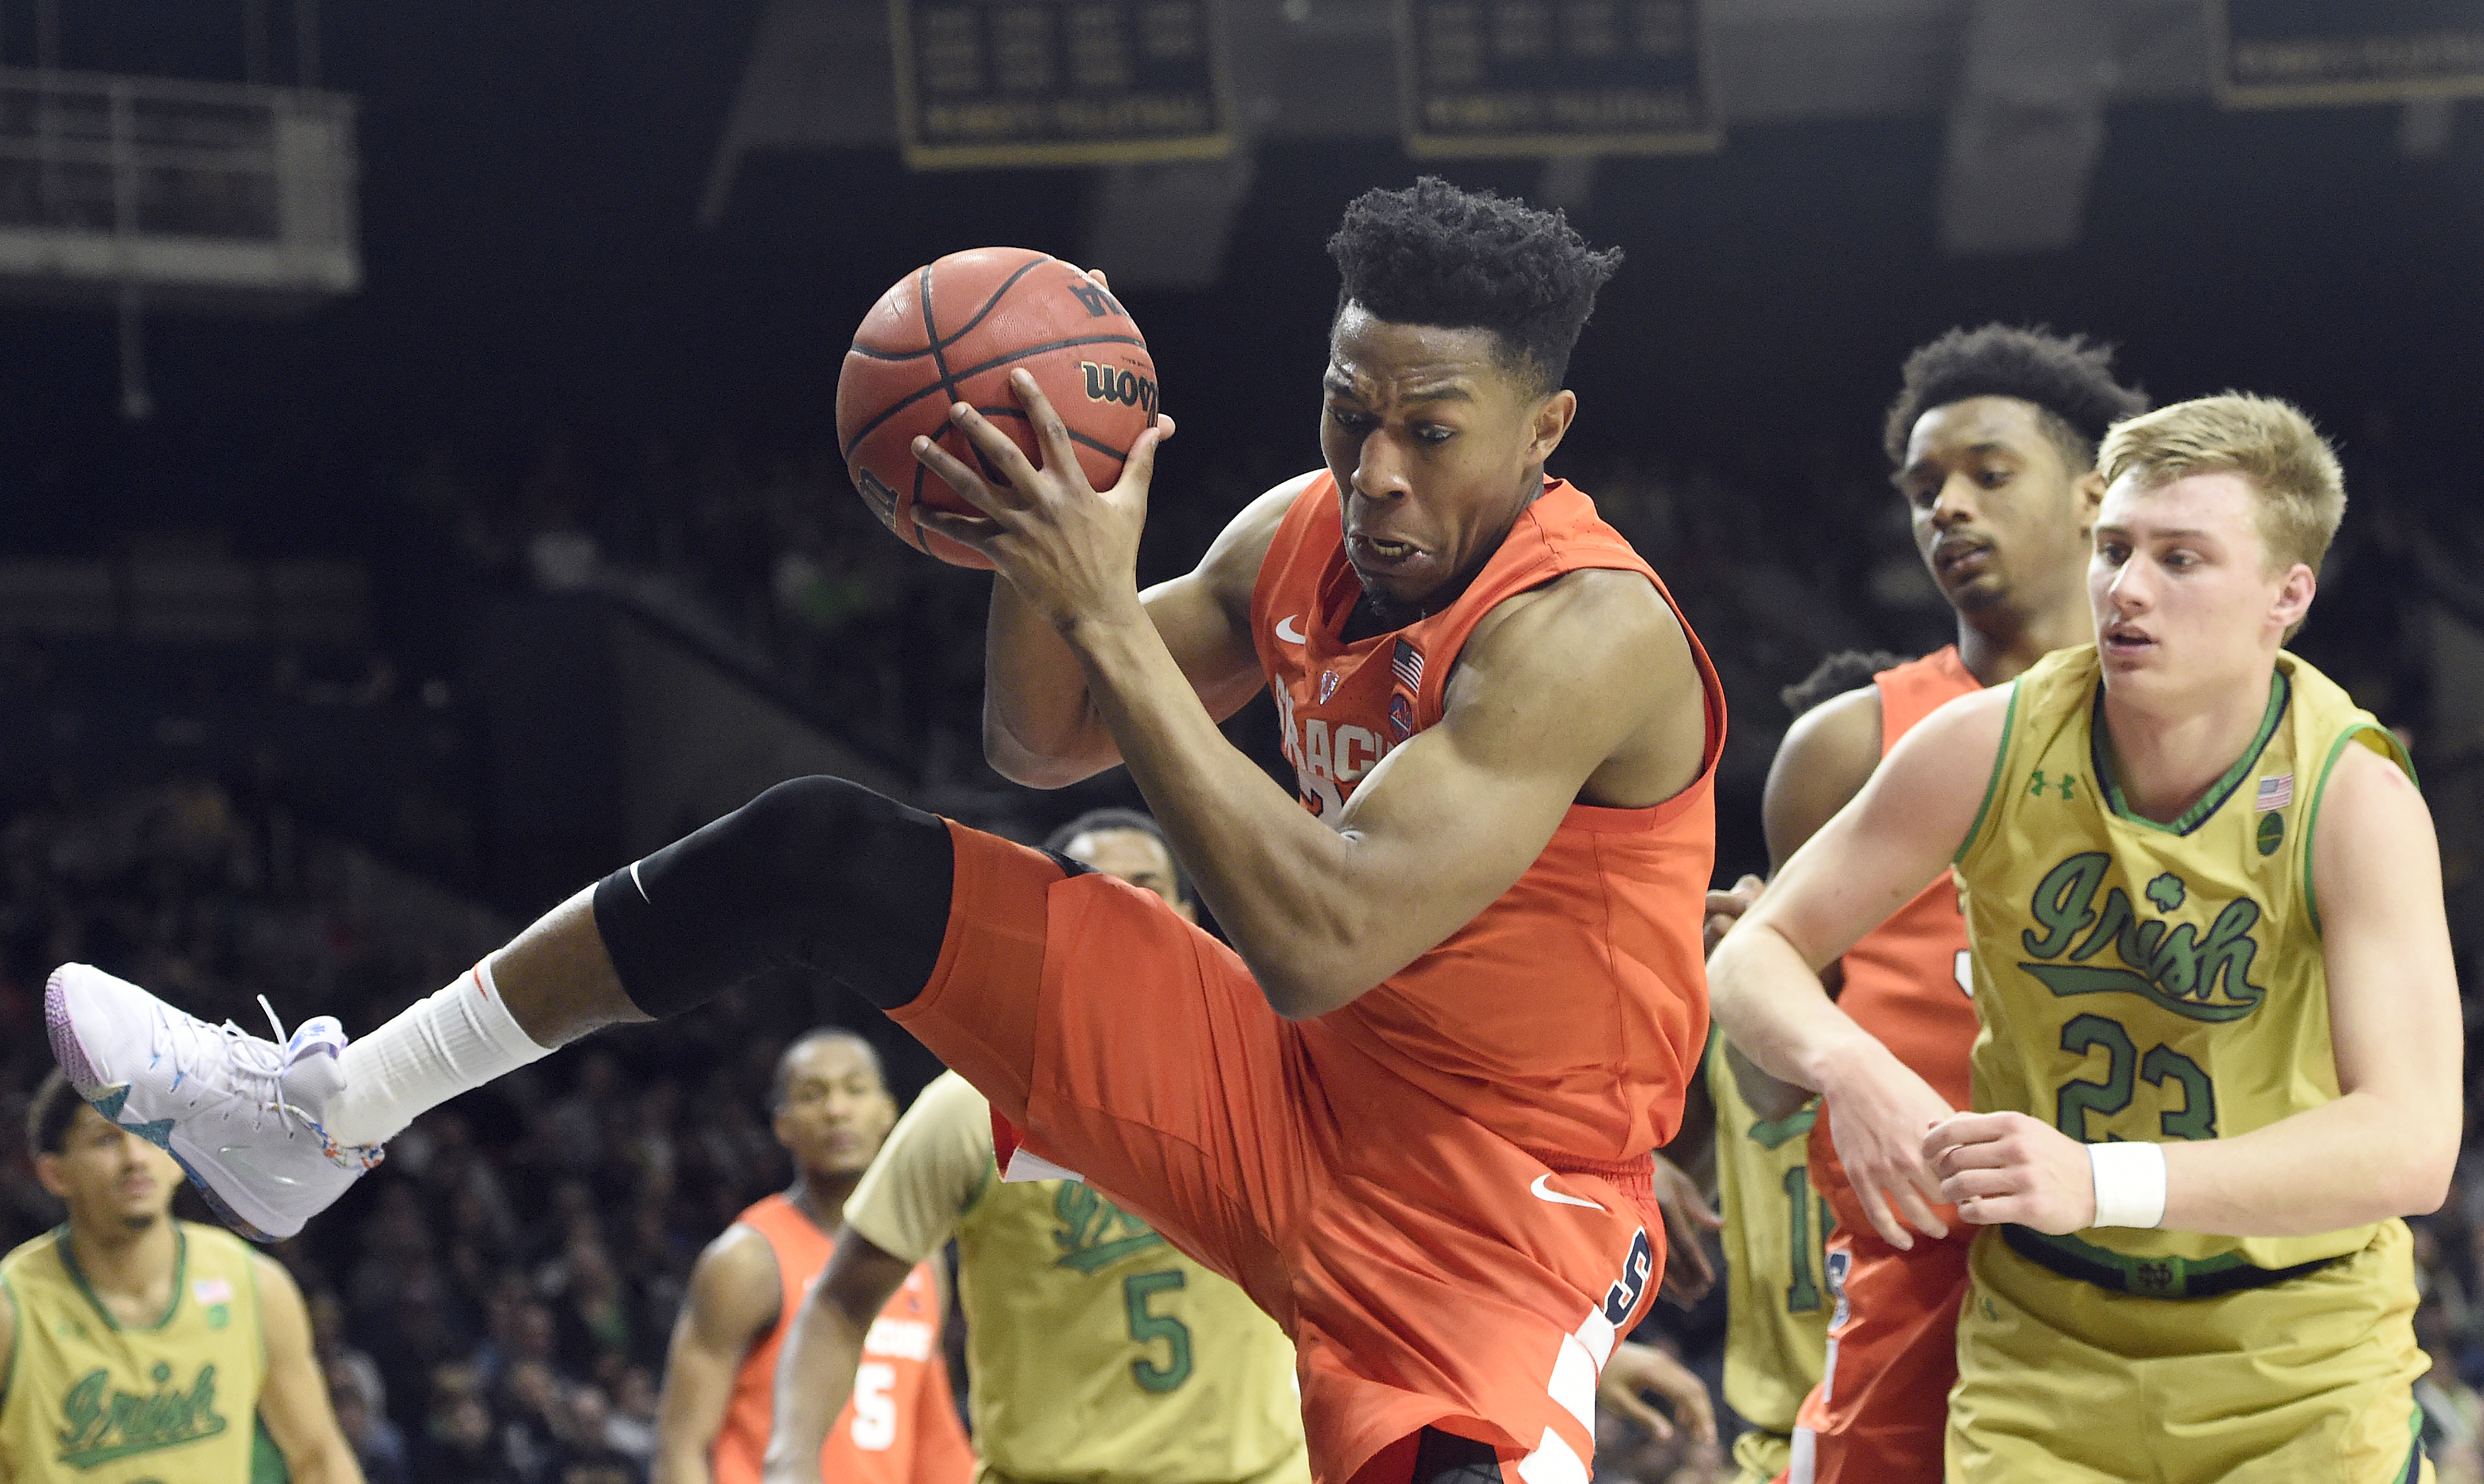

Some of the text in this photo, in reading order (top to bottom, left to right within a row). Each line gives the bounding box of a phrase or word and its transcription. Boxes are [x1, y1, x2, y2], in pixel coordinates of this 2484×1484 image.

[2021, 852, 2266, 1010] Irish
[2057, 1012, 2218, 1143] 23
[1125, 1269, 1192, 1392] 5
[1603, 1225, 1652, 1329] S
[851, 1364, 897, 1451] 5
